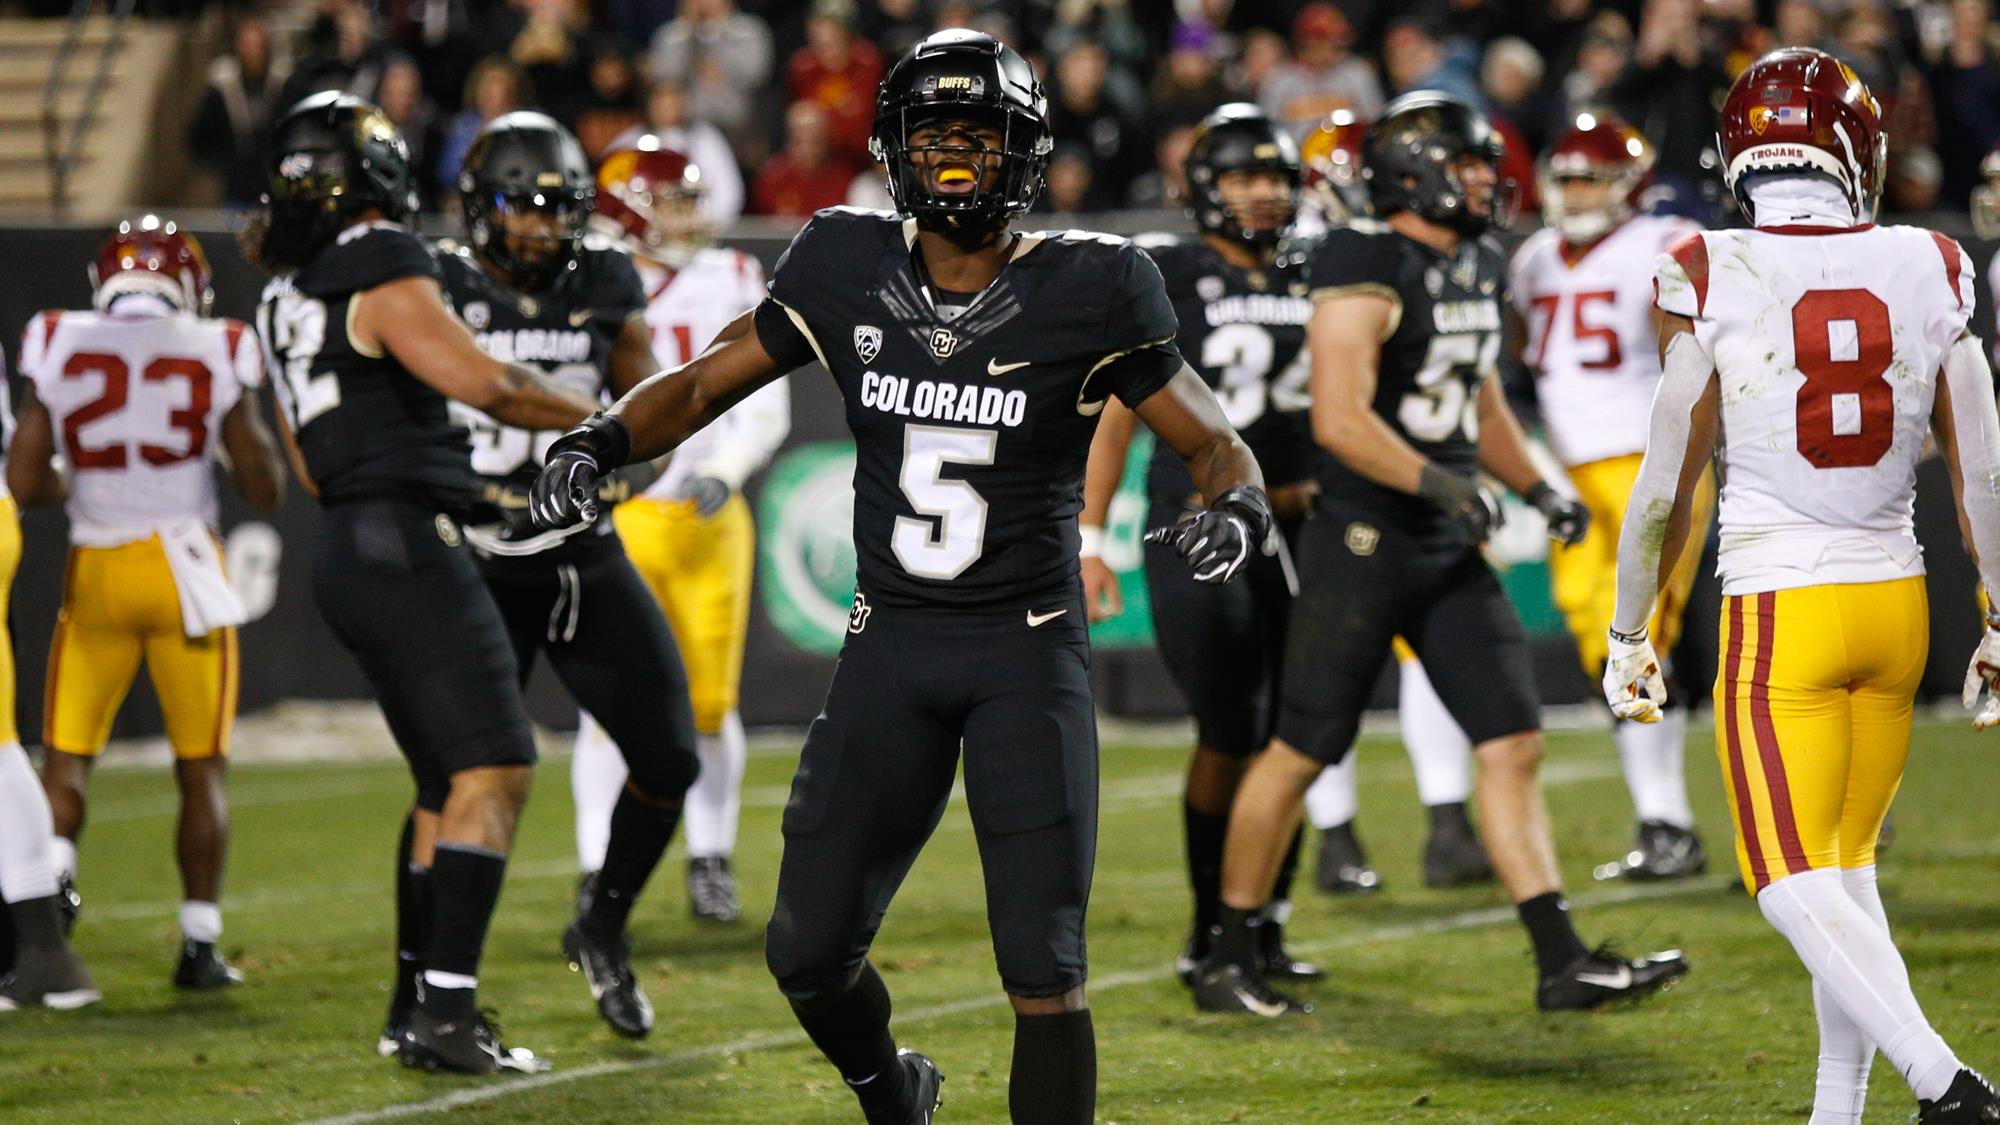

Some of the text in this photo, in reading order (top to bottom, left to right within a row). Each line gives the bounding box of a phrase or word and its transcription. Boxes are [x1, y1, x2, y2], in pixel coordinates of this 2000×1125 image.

[938, 77, 970, 89] BUFFS
[1751, 148, 1804, 160] TROJANS
[861, 342, 874, 357] 12
[1530, 291, 1623, 378] 75
[62, 352, 213, 471] 23
[861, 371, 1027, 427] COLORADO
[1792, 288, 1895, 469] 8
[891, 423, 999, 580] 5
